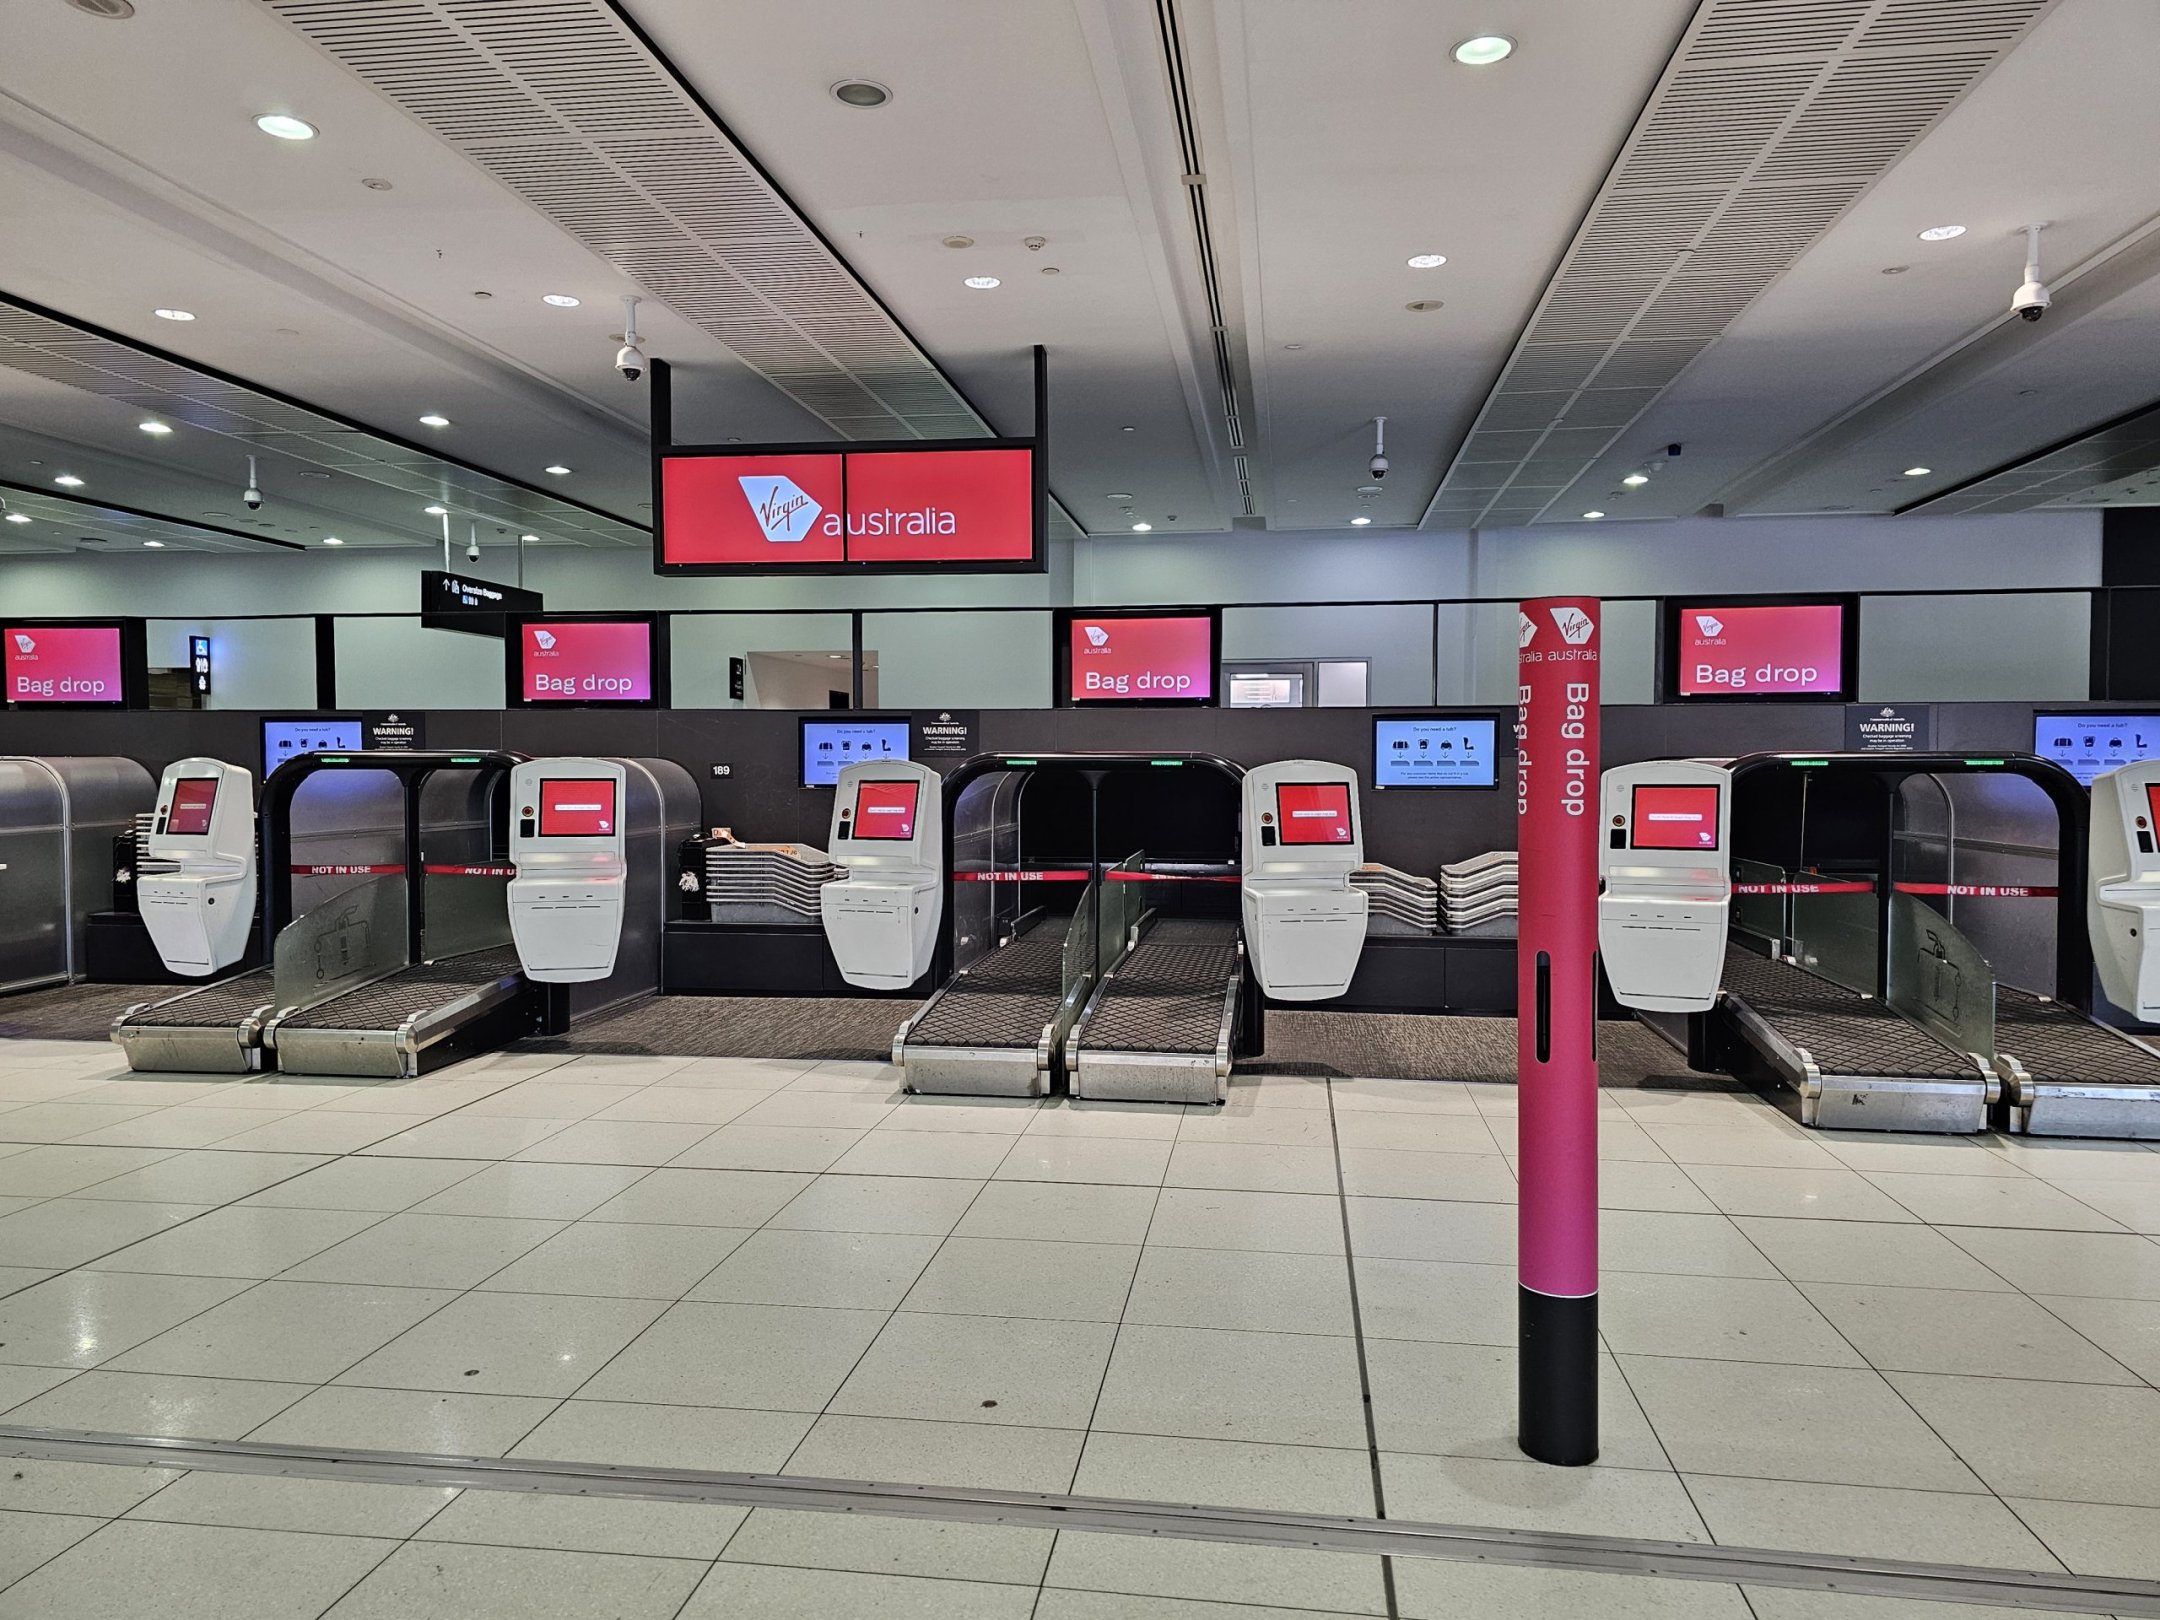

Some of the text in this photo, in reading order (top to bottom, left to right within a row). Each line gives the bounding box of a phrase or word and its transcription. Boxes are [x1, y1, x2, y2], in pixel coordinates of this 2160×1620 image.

[760, 486, 956, 536] Virgin australia
[1562, 613, 1589, 639] Virgin
[1694, 638, 1727, 646] australia
[1548, 649, 1598, 661] australia
[1696, 663, 1818, 688] Bag drop
[17, 676, 105, 697] Bag drop
[535, 673, 633, 695] Bag drop
[1085, 671, 1191, 693] Bag drop
[372, 727, 414, 735] WARNING!
[922, 726, 967, 735] WARNING!
[1859, 723, 1915, 732] WARNING!
[1561, 683, 1590, 816] Bag drop
[712, 765, 730, 775] 189
[311, 865, 371, 874] NOT IN USE
[464, 867, 487, 875] NOT
[491, 868, 504, 876] IN
[977, 871, 1044, 881] NOT IN USE
[1738, 884, 1819, 894] NOT IN USE
[1947, 885, 2029, 897] NOT IN USE
